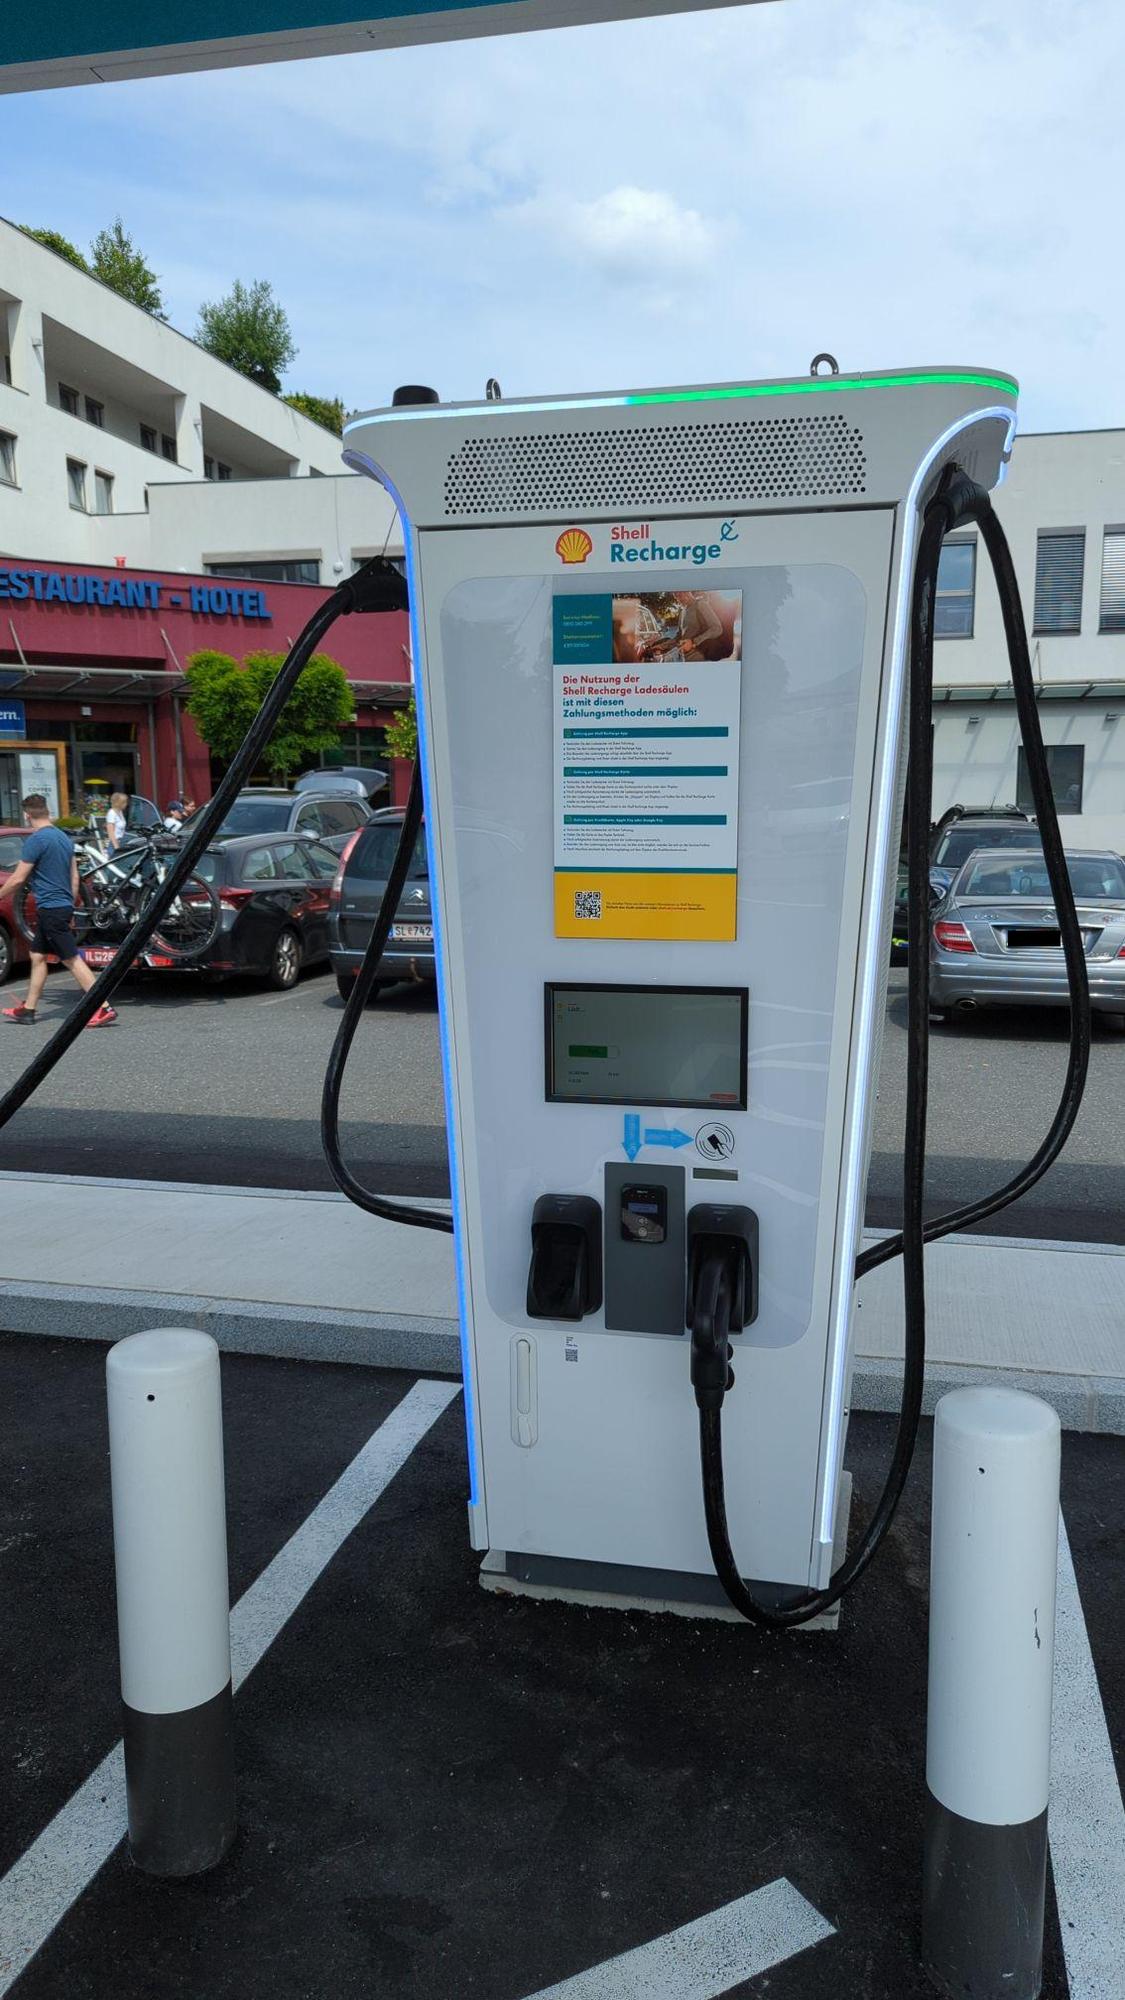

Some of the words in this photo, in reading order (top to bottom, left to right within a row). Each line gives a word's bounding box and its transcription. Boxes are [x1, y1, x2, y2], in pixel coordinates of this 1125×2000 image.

[611, 524, 649, 540] Shell
[610, 540, 721, 565] Recharge
[189, 584, 272, 619] HOTEL
[562, 675, 578, 684] Die
[580, 675, 621, 685] Nutzung
[623, 674, 640, 683] der
[562, 687, 586, 695] Shell
[588, 686, 632, 696] Recharge
[634, 685, 689, 694] Ladesäulen
[562, 697, 574, 706] ist
[576, 697, 591, 706] mit
[593, 697, 624, 706] diesen
[562, 708, 654, 719] Zahlungsmethoden
[656, 707, 697, 718] möglich:
[395, 926, 406, 936] SL
[414, 926, 432, 936] 742
